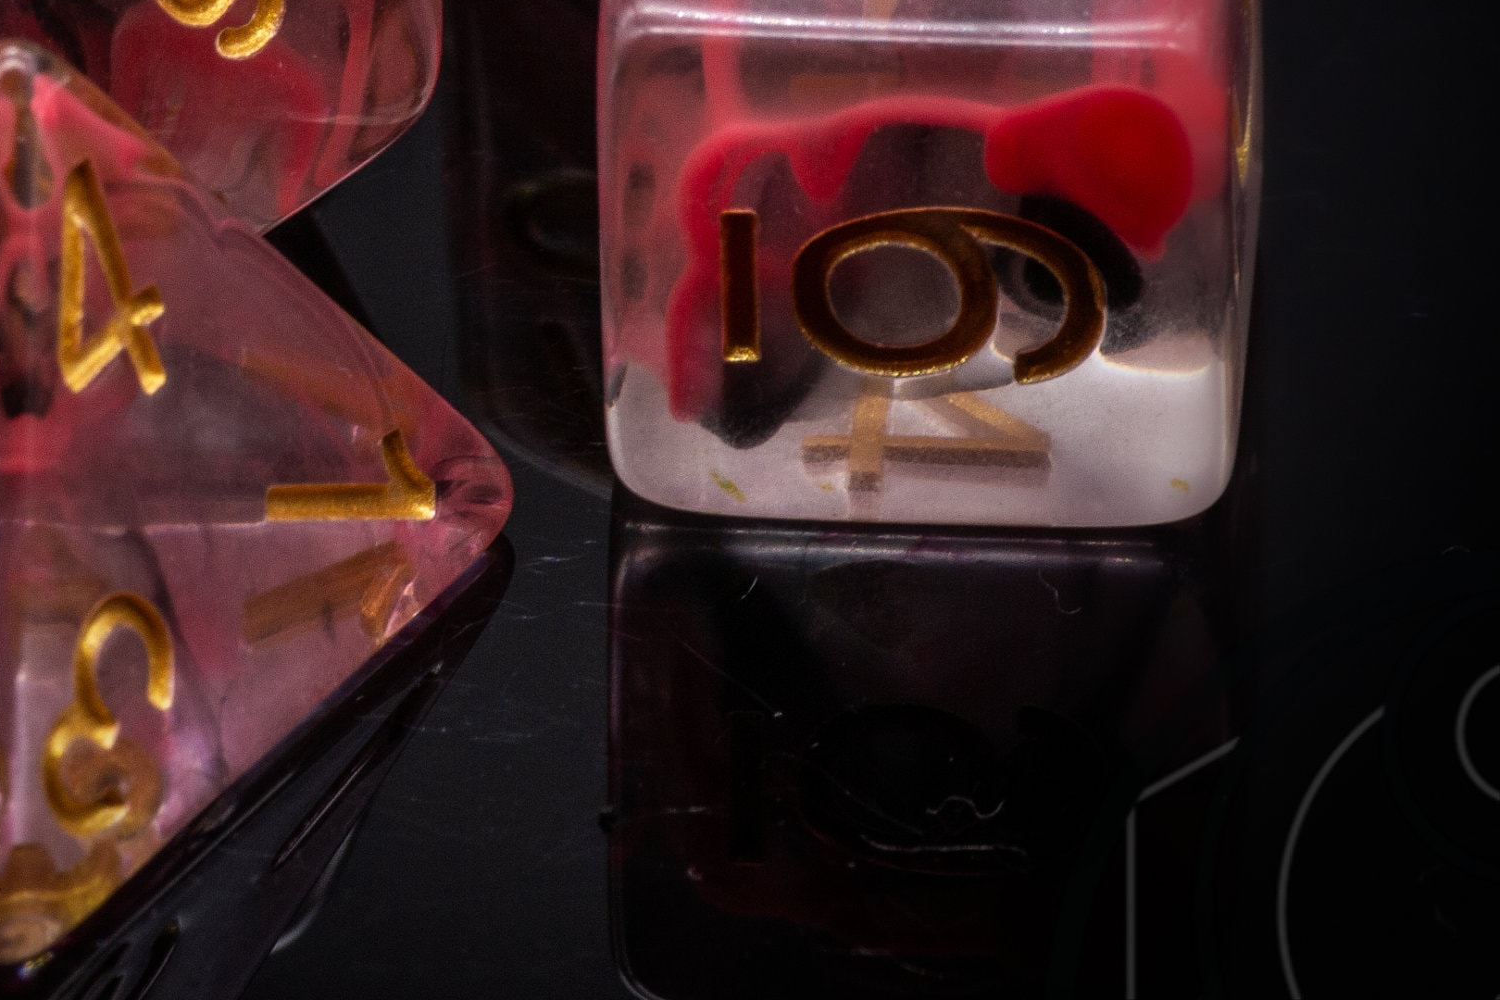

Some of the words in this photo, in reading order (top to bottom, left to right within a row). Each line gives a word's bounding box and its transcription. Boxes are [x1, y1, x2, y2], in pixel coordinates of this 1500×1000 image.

[58, 158, 168, 396] 4
[264, 428, 436, 522] 1
[42, 592, 174, 838] 3
